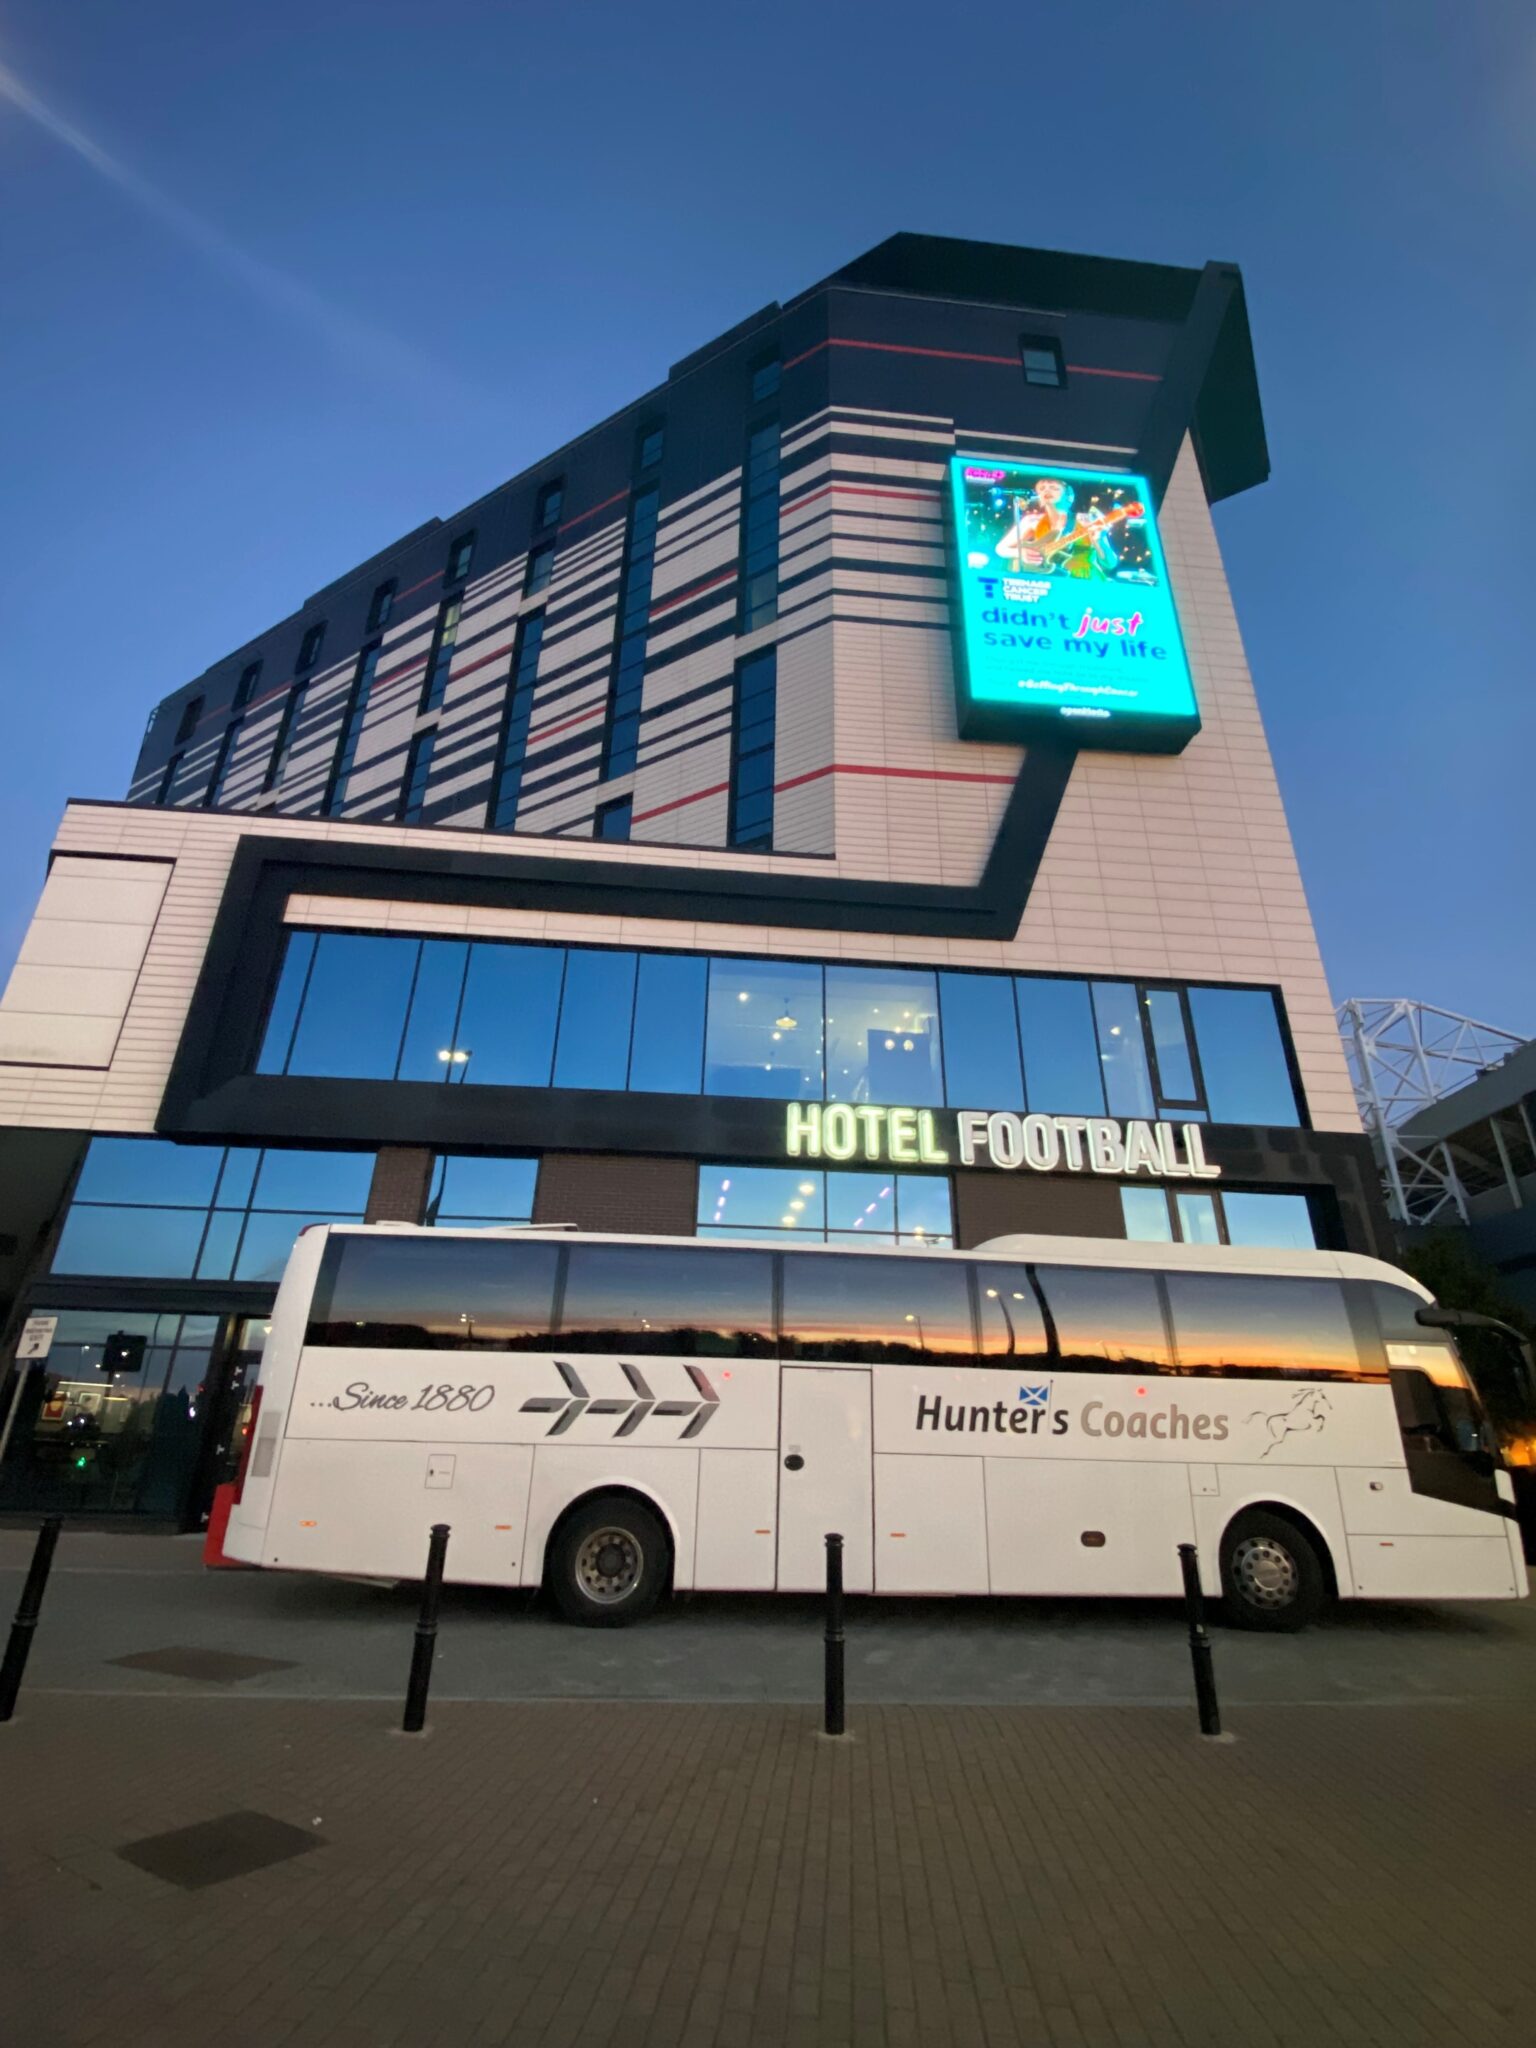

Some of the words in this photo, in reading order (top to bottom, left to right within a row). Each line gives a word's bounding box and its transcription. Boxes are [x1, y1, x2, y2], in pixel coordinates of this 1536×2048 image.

[981, 606, 1071, 630] didn't
[1072, 607, 1144, 638] just
[983, 631, 1053, 650] save
[1063, 638, 1110, 658] my
[1120, 639, 1168, 660] life
[785, 1102, 950, 1166] HOTEL
[957, 1111, 1222, 1179] FOOTBALL
[410, 1384, 495, 1412] 1880
[1080, 1400, 1229, 1441] Coaches
